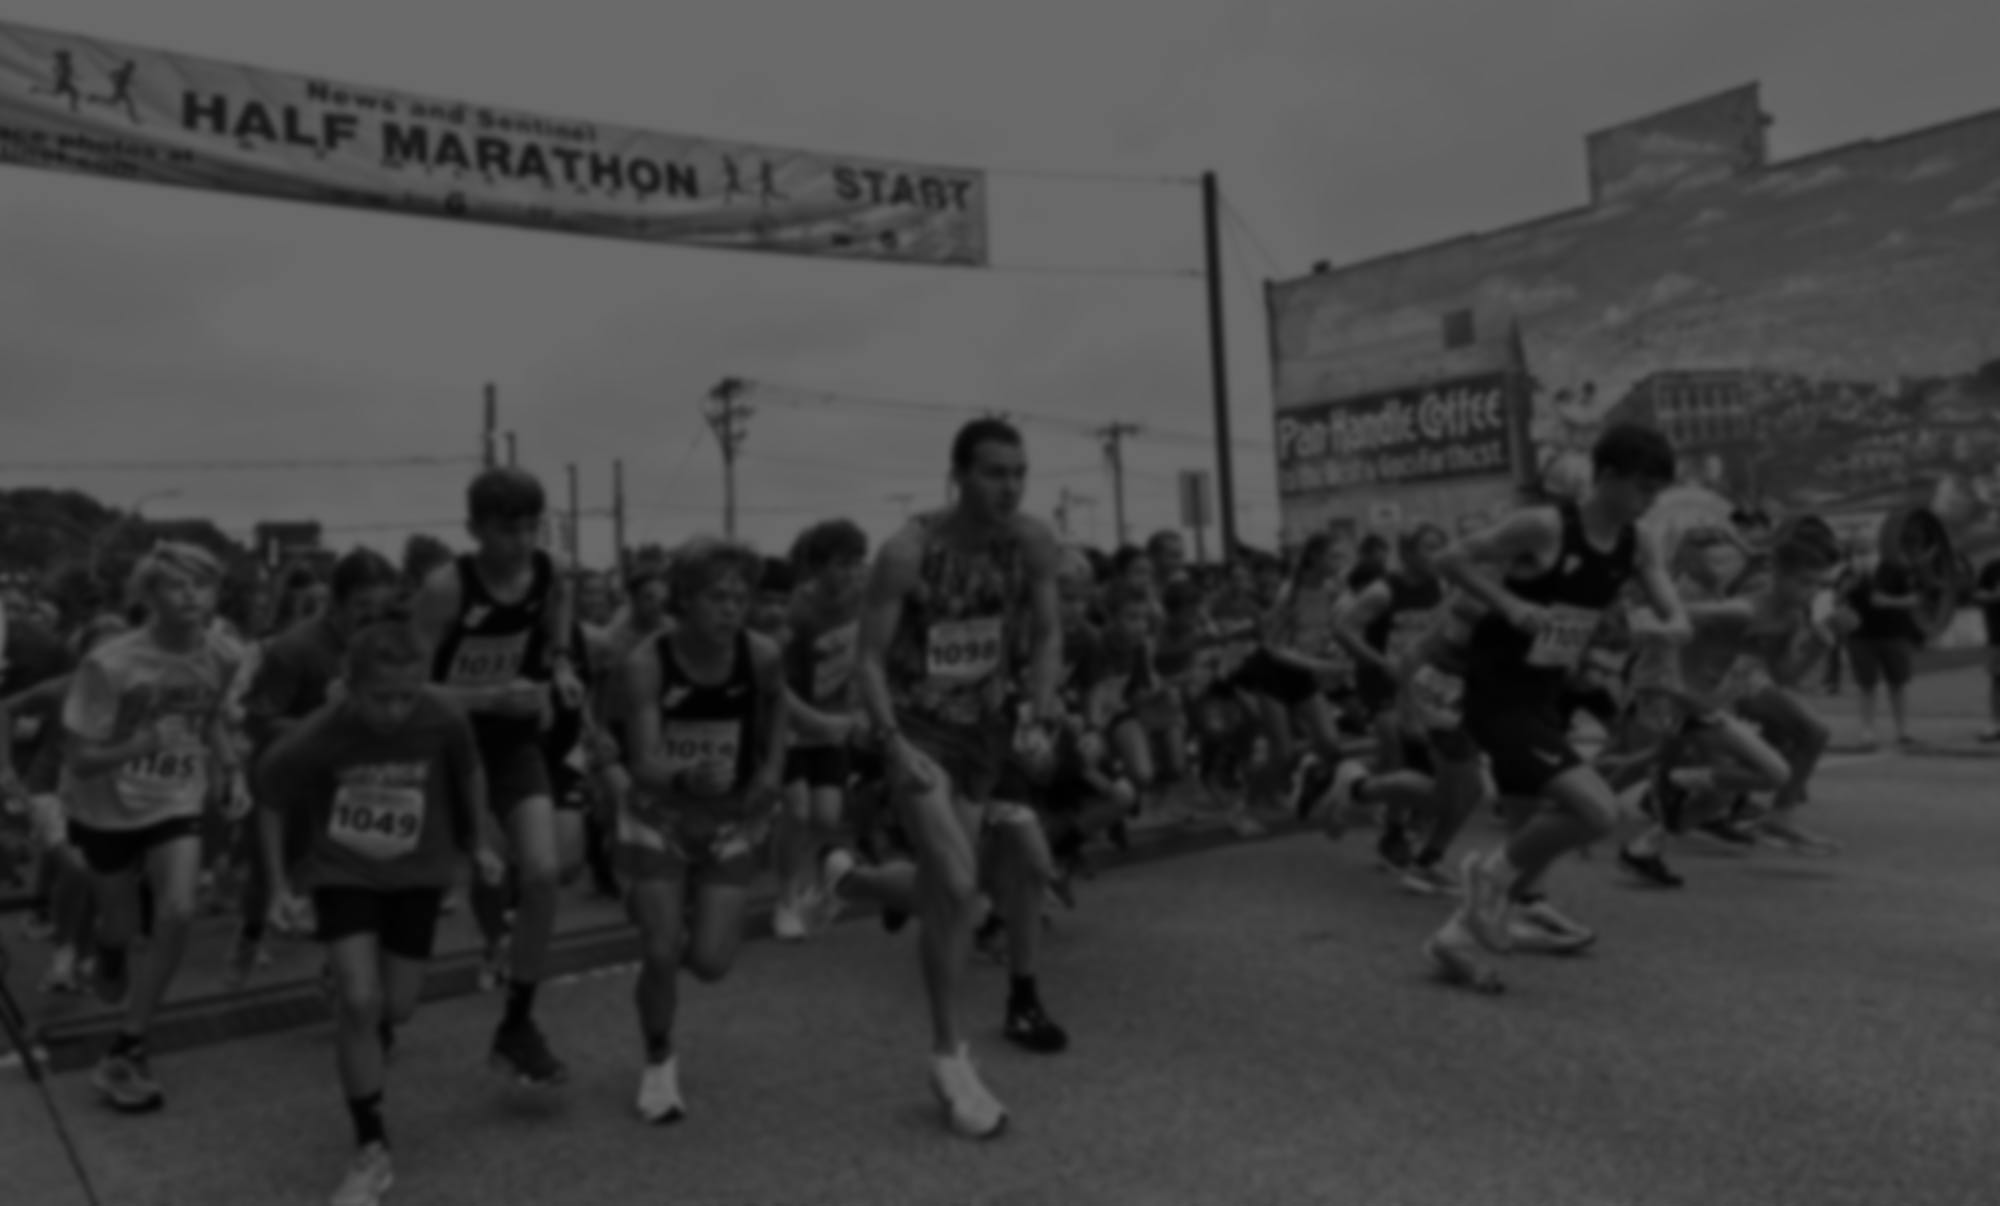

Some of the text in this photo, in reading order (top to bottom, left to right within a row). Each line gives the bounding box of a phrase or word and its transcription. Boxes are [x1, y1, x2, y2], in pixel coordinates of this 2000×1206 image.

[306, 79, 596, 142] News and Sentinel
[182, 90, 358, 151] HALF
[382, 121, 700, 201] MARATHON
[833, 165, 973, 212] START
[1279, 387, 1501, 461] Pan Handle Coffee
[338, 804, 417, 839] 1049
